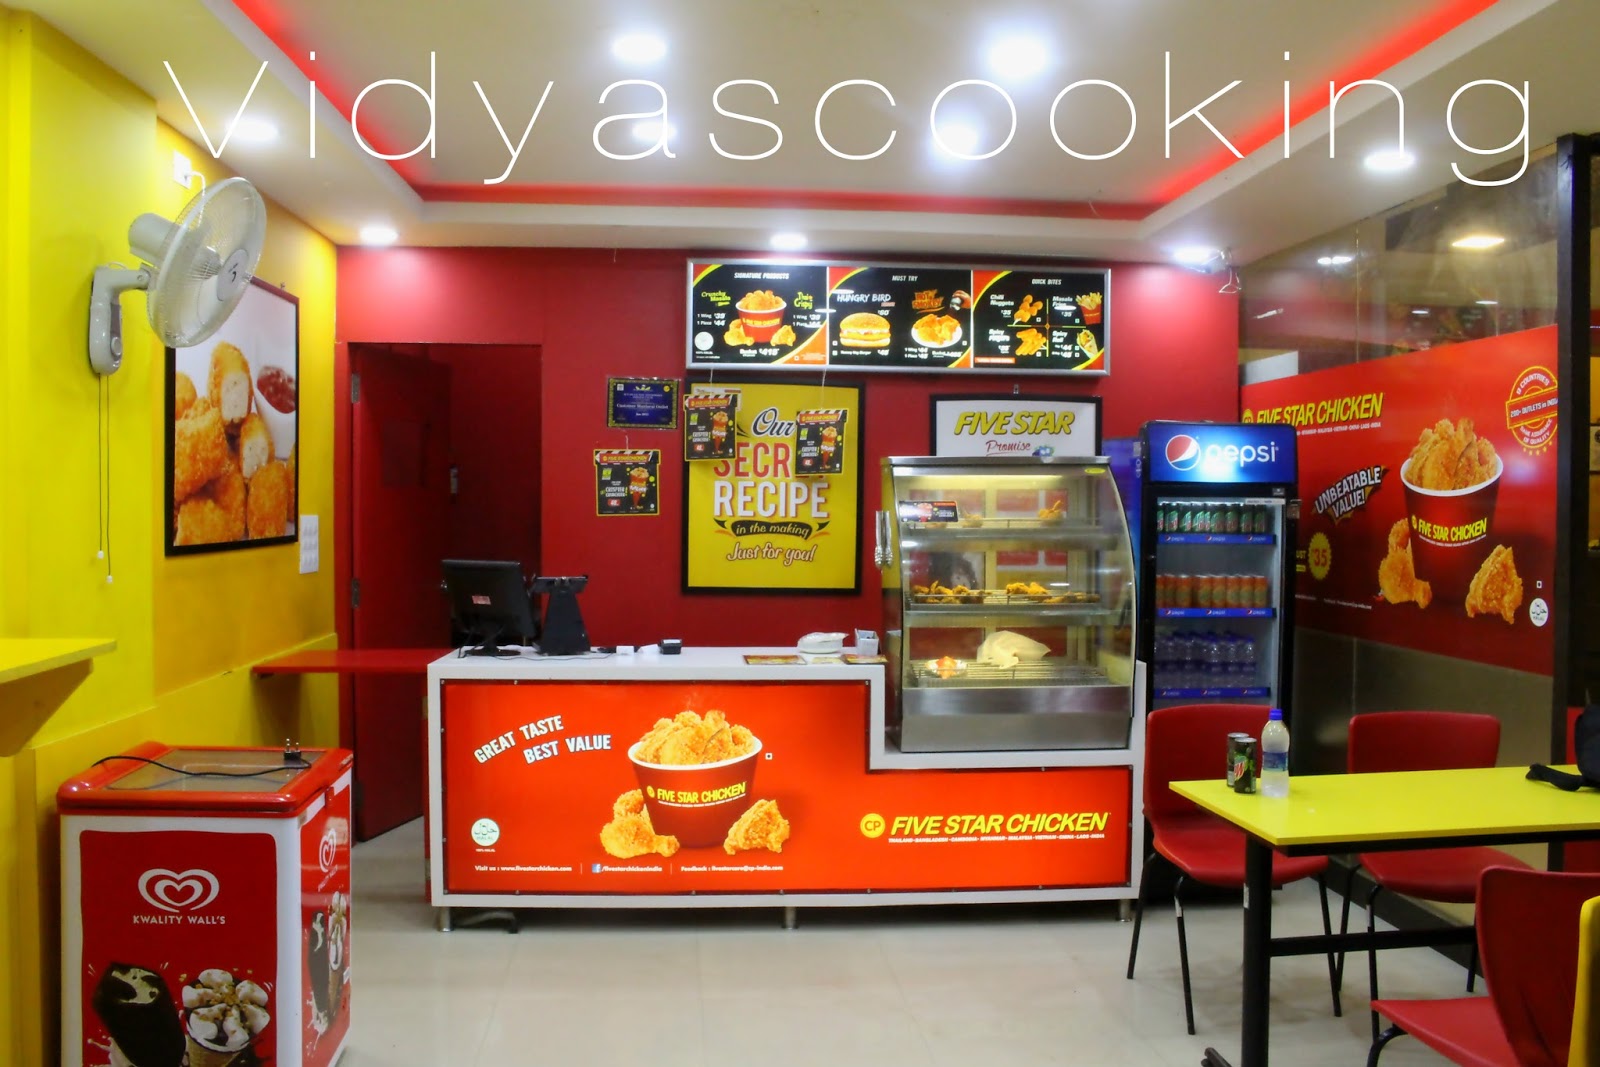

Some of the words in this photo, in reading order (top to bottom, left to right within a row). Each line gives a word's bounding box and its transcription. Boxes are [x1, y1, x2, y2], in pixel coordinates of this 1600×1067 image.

[837, 293, 870, 303] HUNGRY
[872, 293, 891, 303] BIRD
[1520, 373, 1550, 389] COUNTRIES
[1257, 408, 1282, 423] FIVE
[1282, 403, 1316, 427] STAR
[1316, 392, 1384, 425] CHICKEN
[1522, 403, 1541, 415] OUTLETS
[752, 407, 795, 438] Our
[954, 411, 1013, 435] FIVE
[1011, 410, 1075, 436] STAR
[985, 439, 1031, 453] Promise
[1530, 431, 1550, 445] QUALITY
[713, 441, 826, 478] SECR
[1205, 441, 1276, 468] pepsi
[713, 480, 830, 519] RECIPE
[1315, 467, 1382, 514] UNBEATABLE
[1331, 488, 1366, 518] VALUE!
[736, 523, 746, 533] in
[749, 521, 767, 534] the
[769, 522, 811, 538] making
[1418, 518, 1432, 538] FIVE
[1433, 524, 1449, 542] STAR
[1450, 517, 1488, 542] CHICKEN
[726, 542, 758, 561] Just
[762, 541, 783, 559] for
[785, 543, 818, 566] you!
[473, 731, 516, 764] GREAT
[518, 715, 564, 741] TASTE
[523, 740, 559, 765] BEST
[564, 734, 612, 753] VALUE
[657, 788, 675, 802] FIVE
[677, 791, 699, 803] STAR
[701, 781, 746, 803] CHICKEN
[890, 816, 944, 836] FIVE
[944, 814, 1004, 835] STAR
[1006, 812, 1109, 834] CHICKEN
[133, 915, 183, 925] KWALITY
[187, 915, 226, 925] WALL'S
